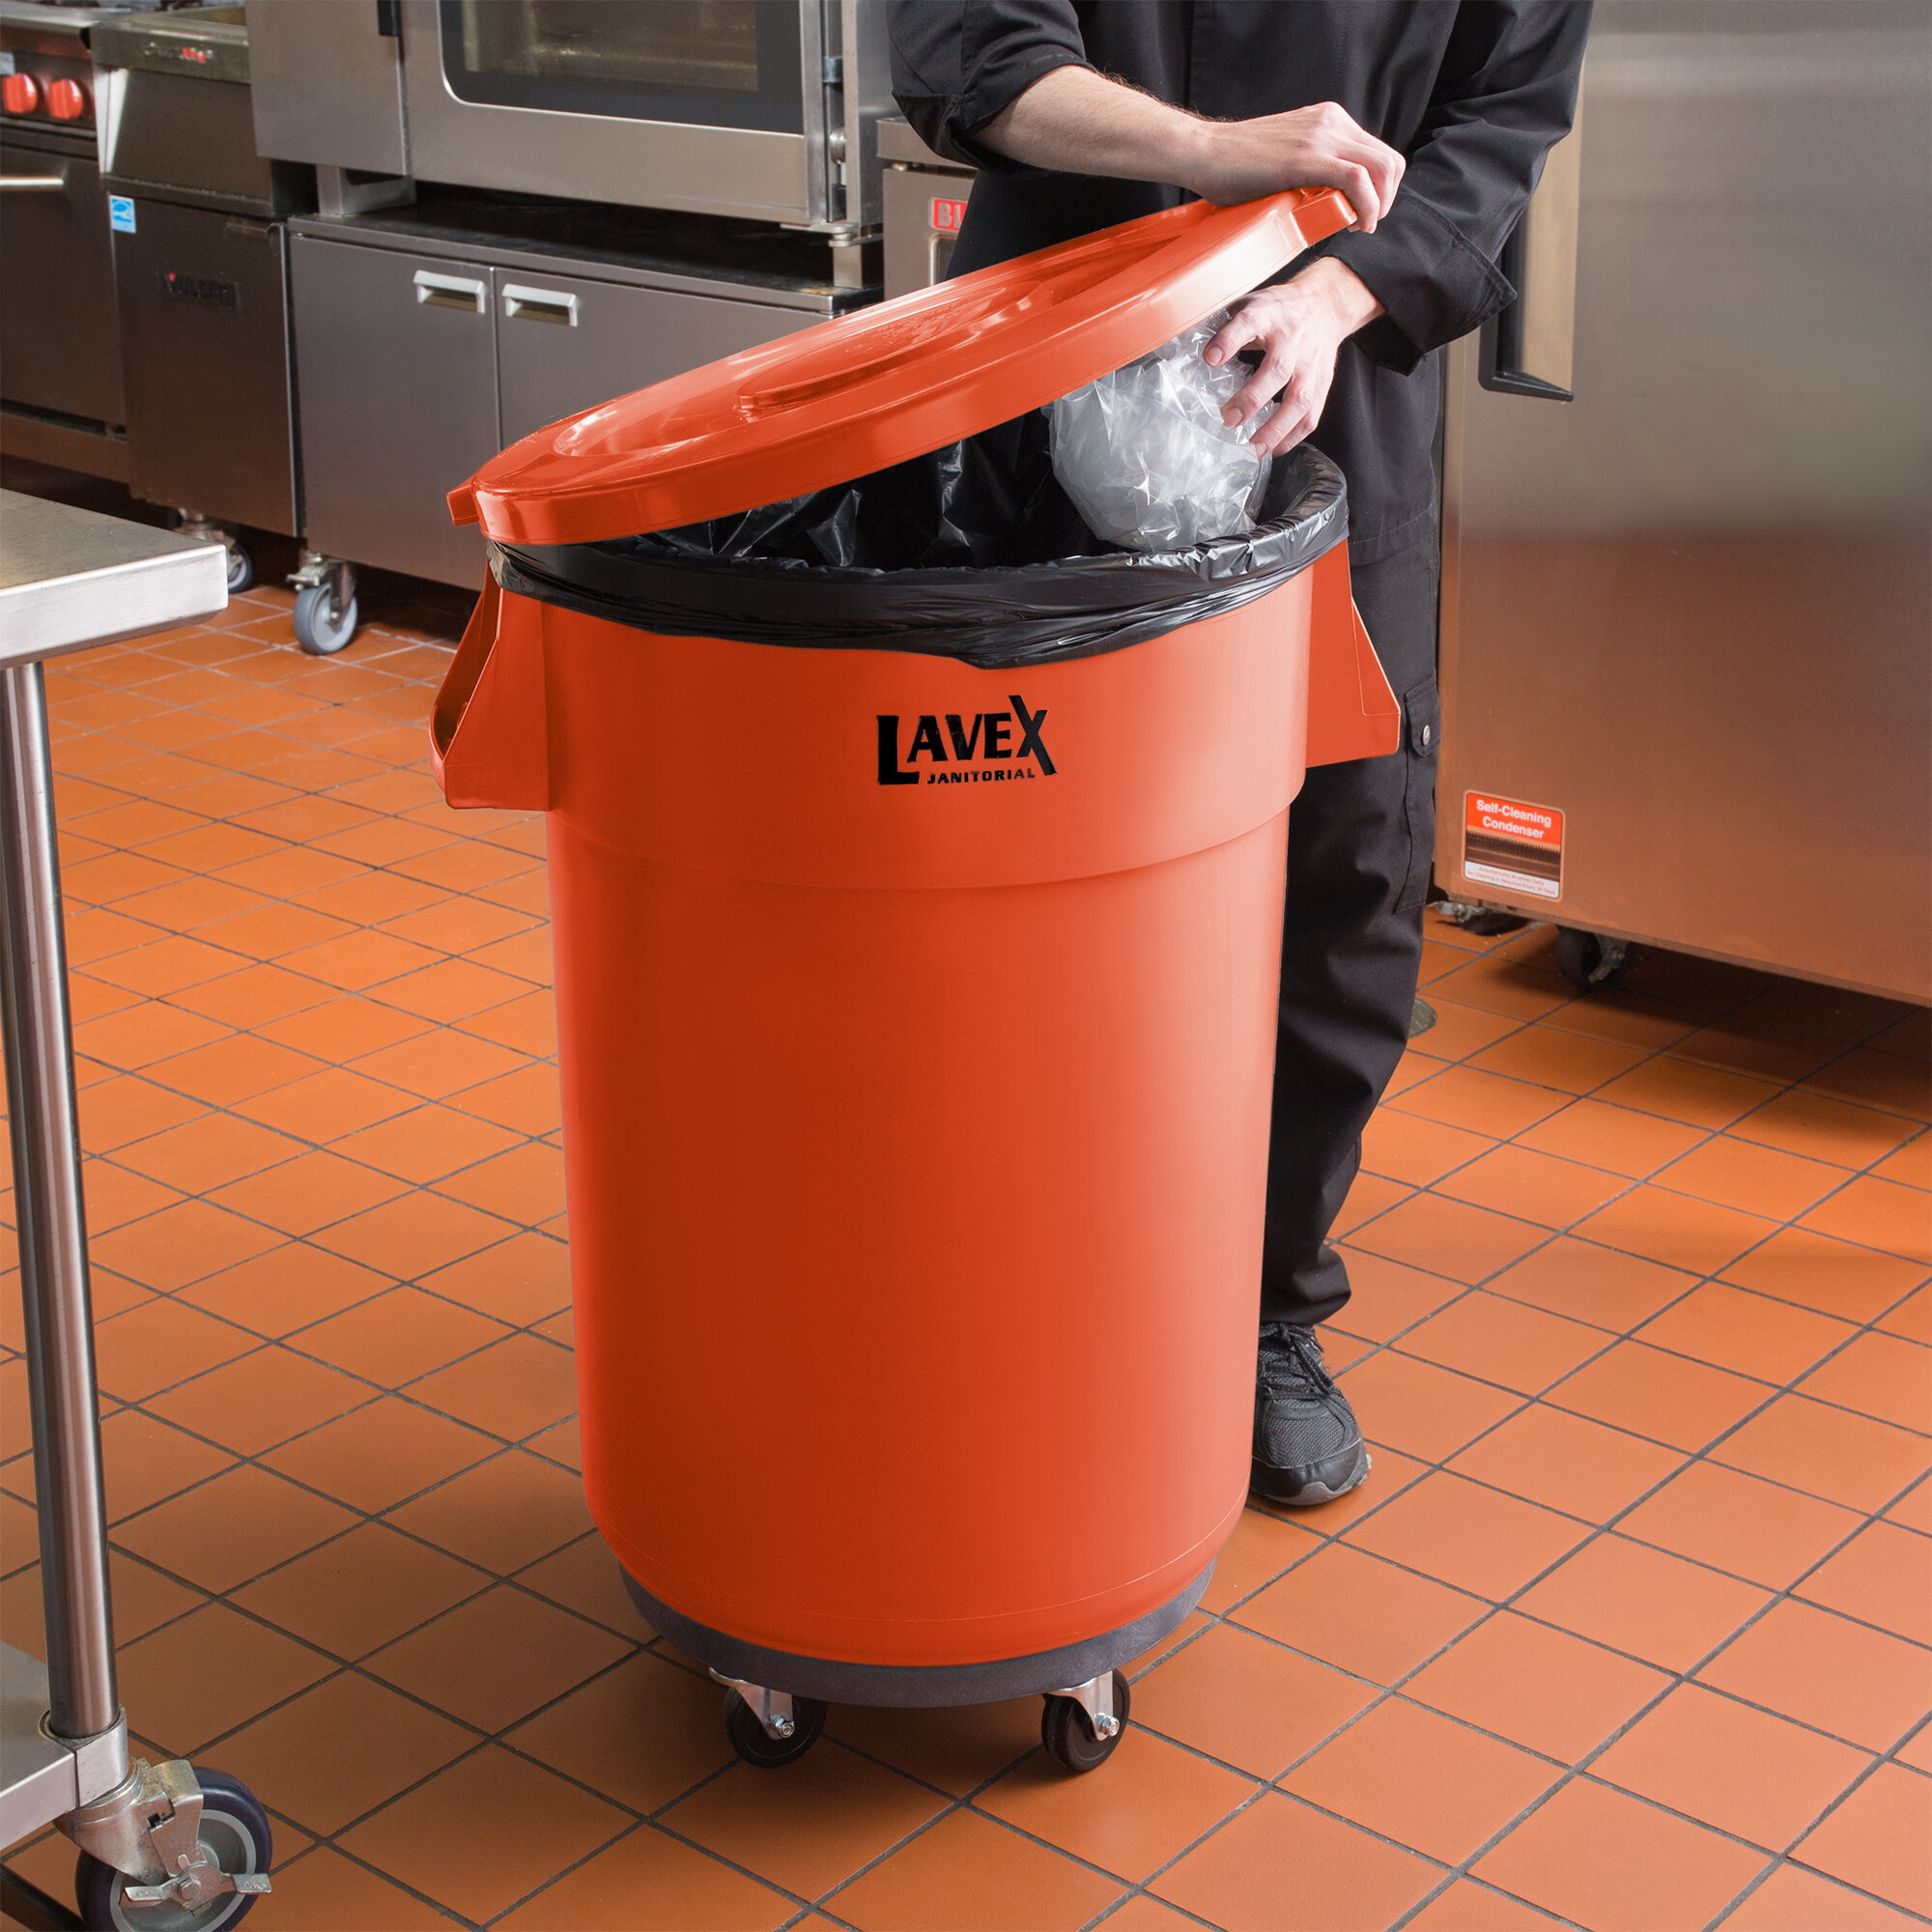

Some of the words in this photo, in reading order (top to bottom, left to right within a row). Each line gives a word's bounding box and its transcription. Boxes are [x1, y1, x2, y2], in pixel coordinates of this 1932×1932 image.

[876, 695, 1058, 785] LAVEX
[927, 768, 1036, 784] JANITORIAL
[1476, 799, 1551, 828] Self-Cleaning
[1482, 815, 1545, 838] Condenser
